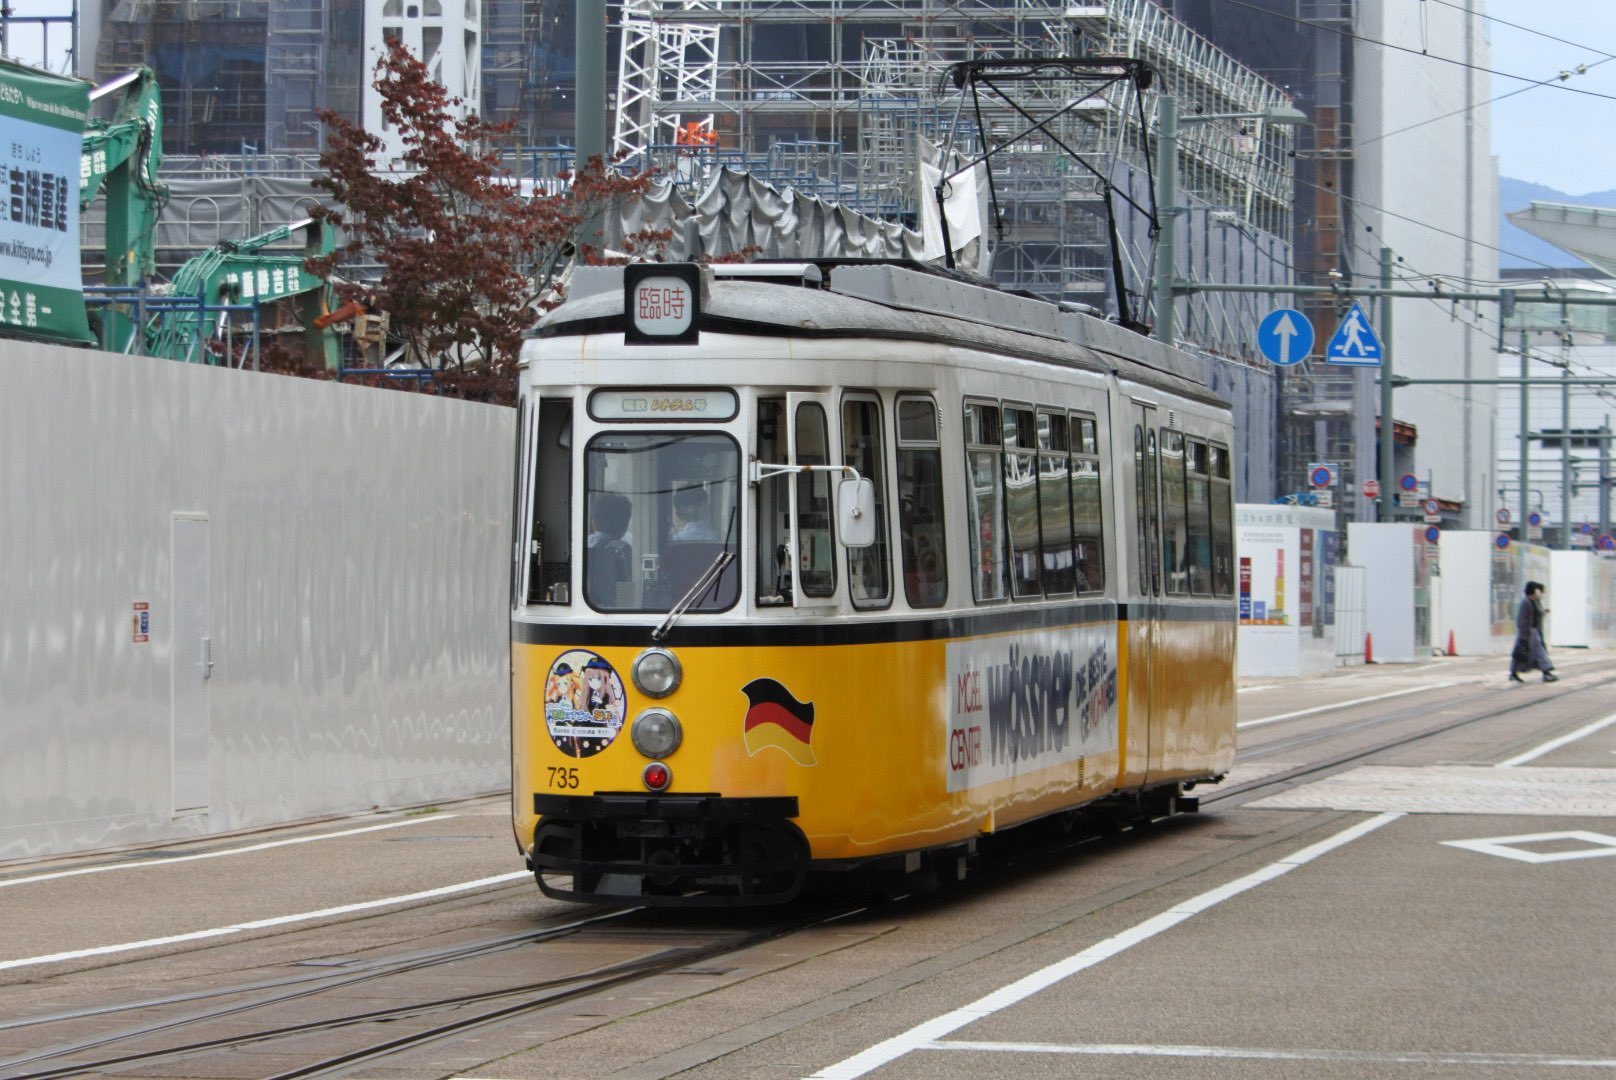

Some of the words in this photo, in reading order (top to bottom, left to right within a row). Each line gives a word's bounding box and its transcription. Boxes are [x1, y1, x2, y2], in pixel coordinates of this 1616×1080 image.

[639, 287, 685, 319] 臨時
[986, 642, 1073, 767] Wössner
[950, 726, 983, 772] CENTER
[547, 767, 579, 789] 735
